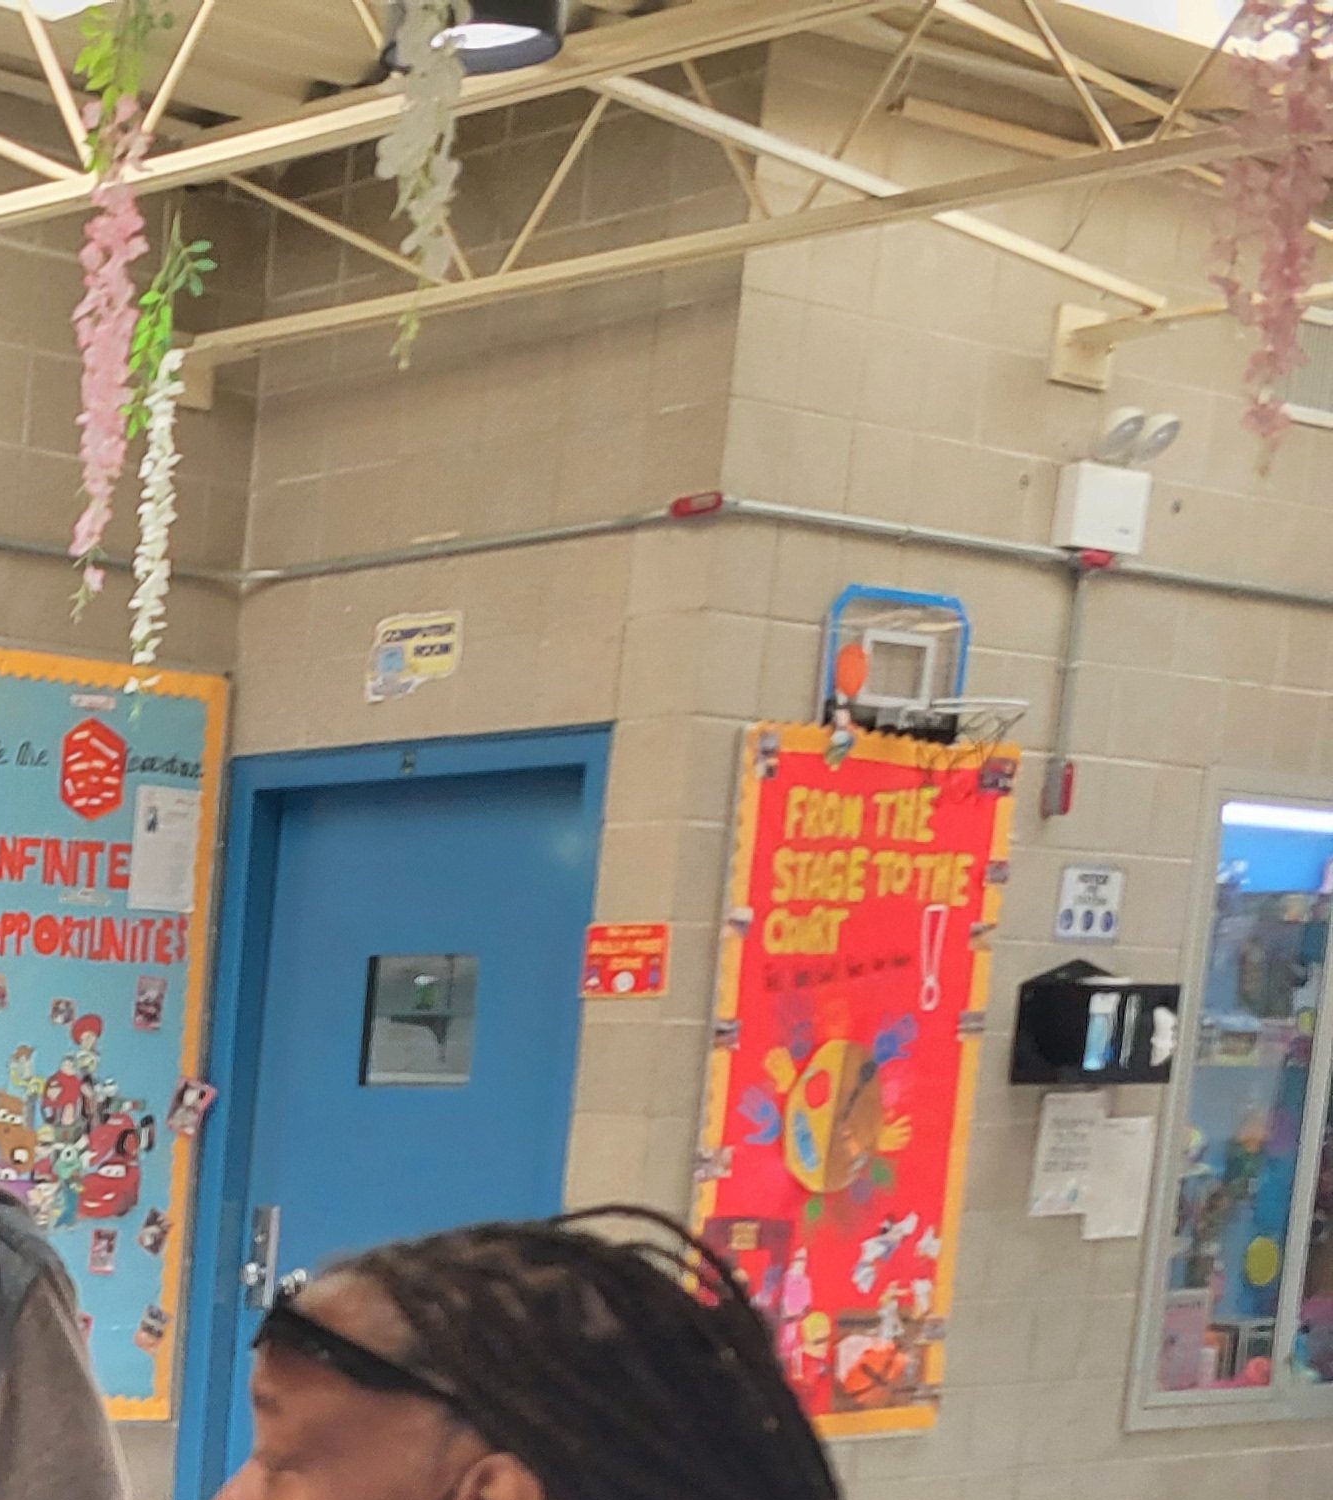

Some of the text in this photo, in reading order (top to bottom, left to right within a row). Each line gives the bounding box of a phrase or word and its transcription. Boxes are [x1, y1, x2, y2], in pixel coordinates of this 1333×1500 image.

[785, 786, 941, 843] FROM THE
[771, 846, 975, 907] STAGE TO THE
